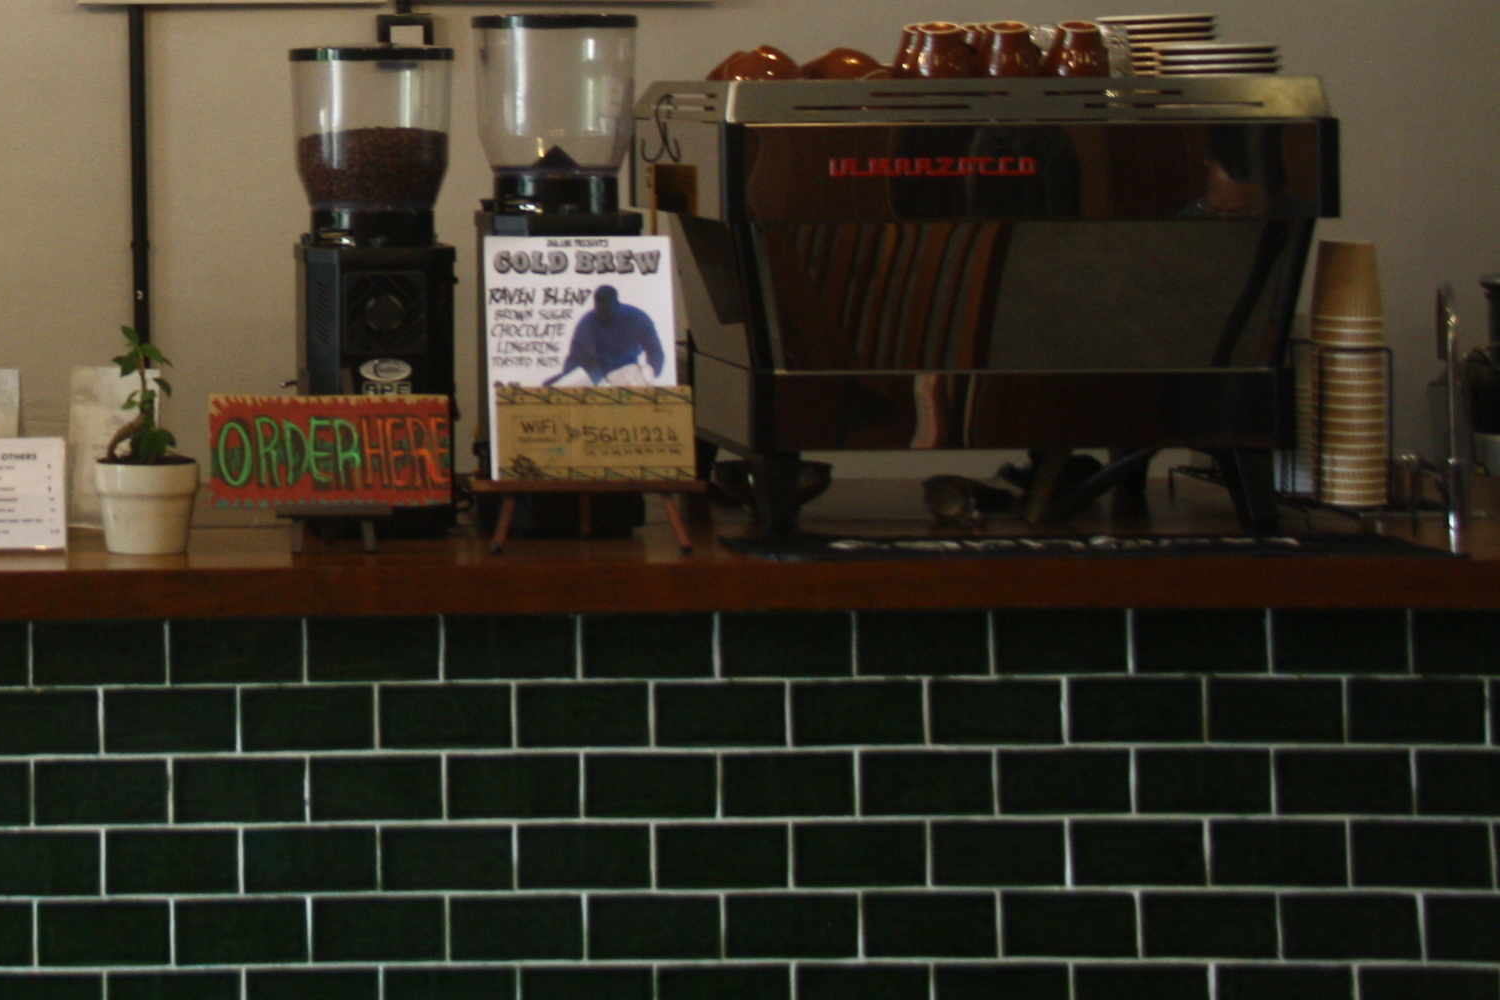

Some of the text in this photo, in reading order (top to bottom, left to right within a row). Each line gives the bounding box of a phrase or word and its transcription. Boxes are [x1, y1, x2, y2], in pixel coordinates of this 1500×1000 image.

[575, 250, 660, 275] BREW
[488, 286, 592, 307] RAVEN BLEND
[495, 309, 534, 321] BROWN
[491, 323, 566, 339] CHOCOLATE
[1, 453, 37, 461] OTHERS
[218, 415, 450, 489] ORDER HERE
